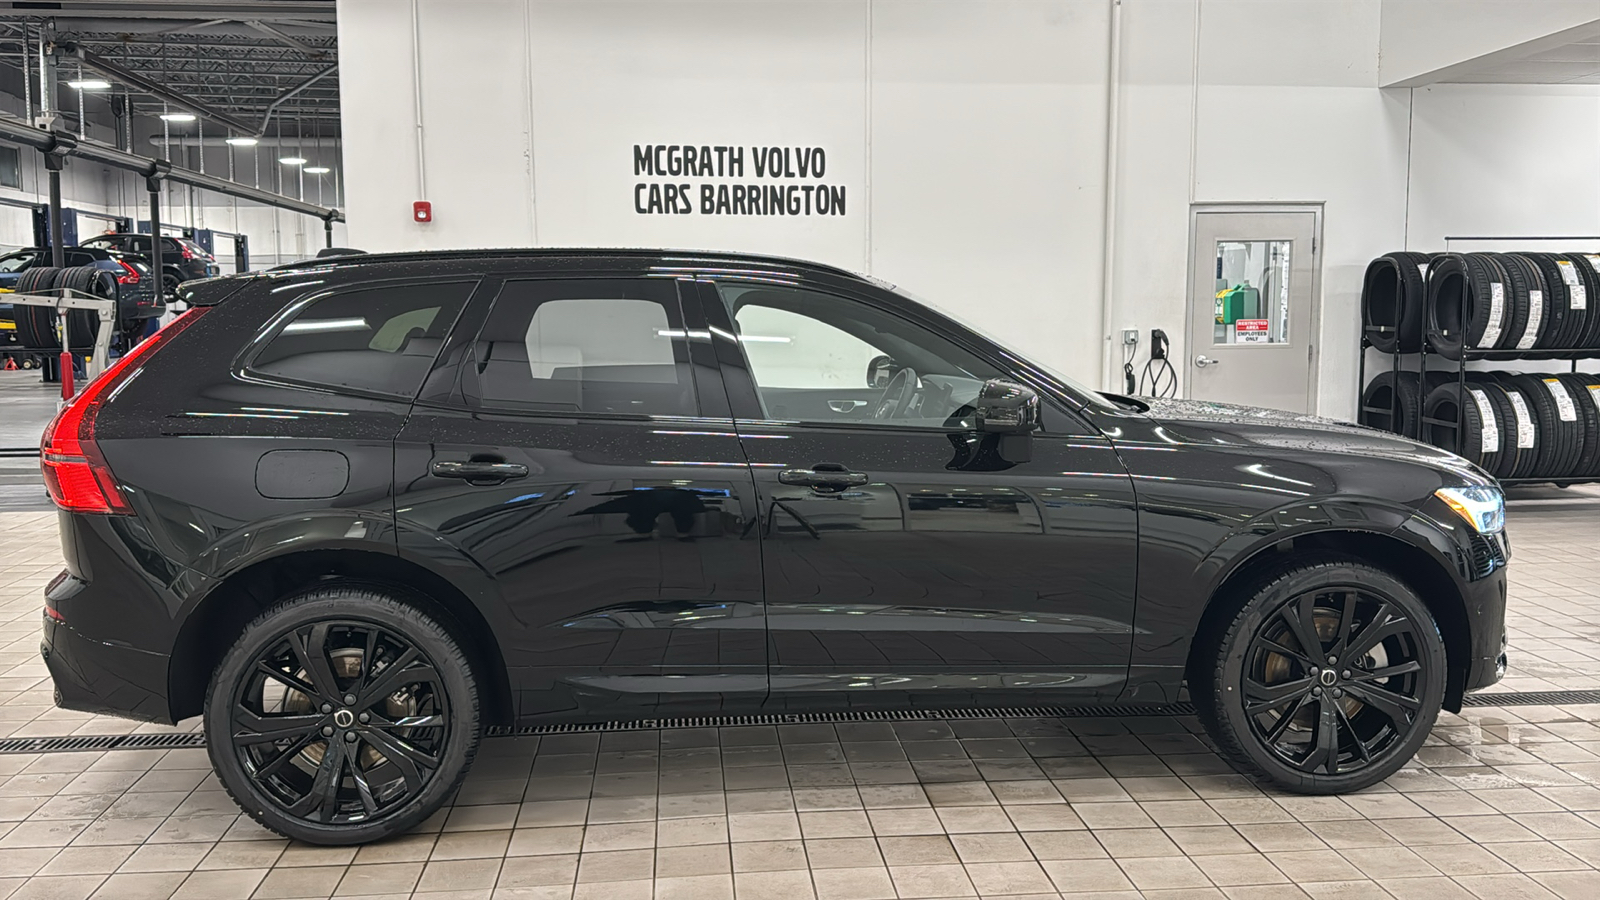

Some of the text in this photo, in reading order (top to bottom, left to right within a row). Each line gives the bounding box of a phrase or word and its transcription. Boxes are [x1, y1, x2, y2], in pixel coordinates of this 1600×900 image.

[633, 145, 826, 178] MCGRATH VOLVO
[634, 183, 846, 216] CARS BARRINGTON
